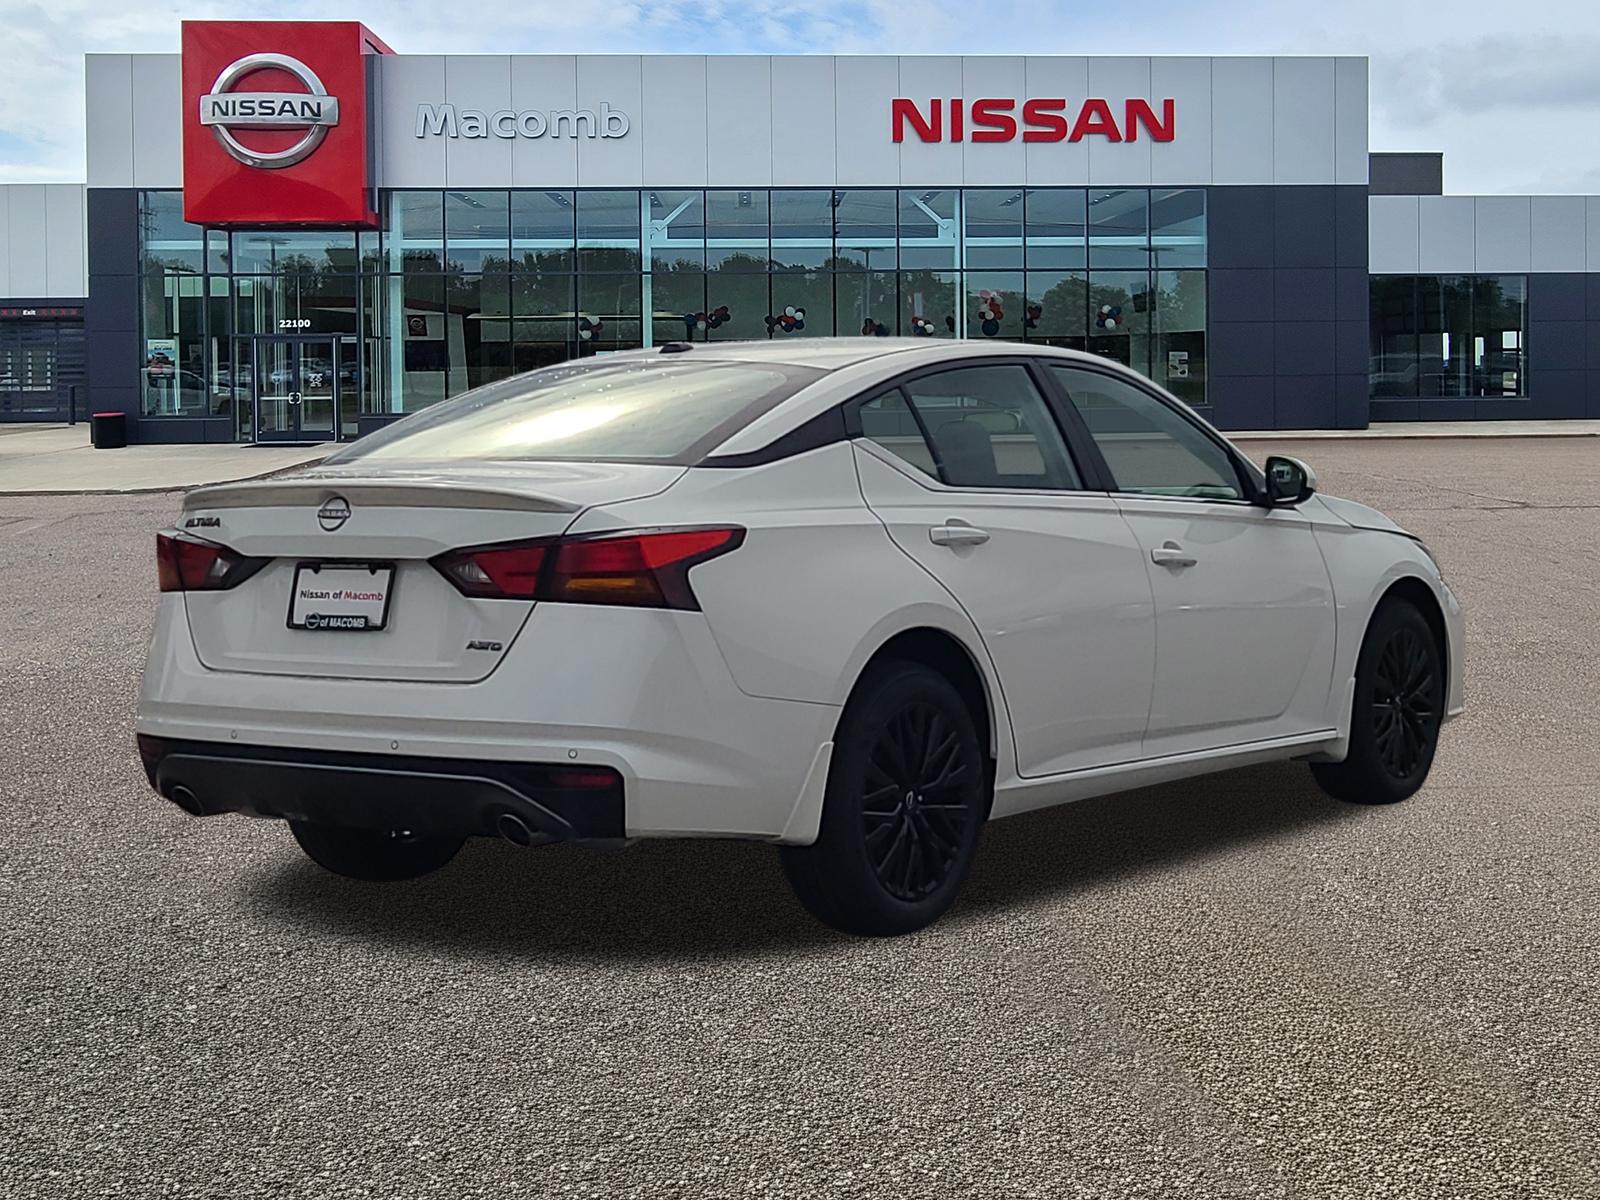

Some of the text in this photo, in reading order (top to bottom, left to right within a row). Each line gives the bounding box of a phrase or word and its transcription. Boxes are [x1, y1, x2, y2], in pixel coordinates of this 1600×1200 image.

[211, 100, 322, 118] NISSAN
[415, 102, 631, 141] Macomb
[892, 98, 1176, 143] NISSAN
[279, 319, 311, 328] 22100
[300, 589, 384, 601] Nissan of Macomb
[319, 617, 330, 627] of
[329, 617, 365, 628] MACOMB
